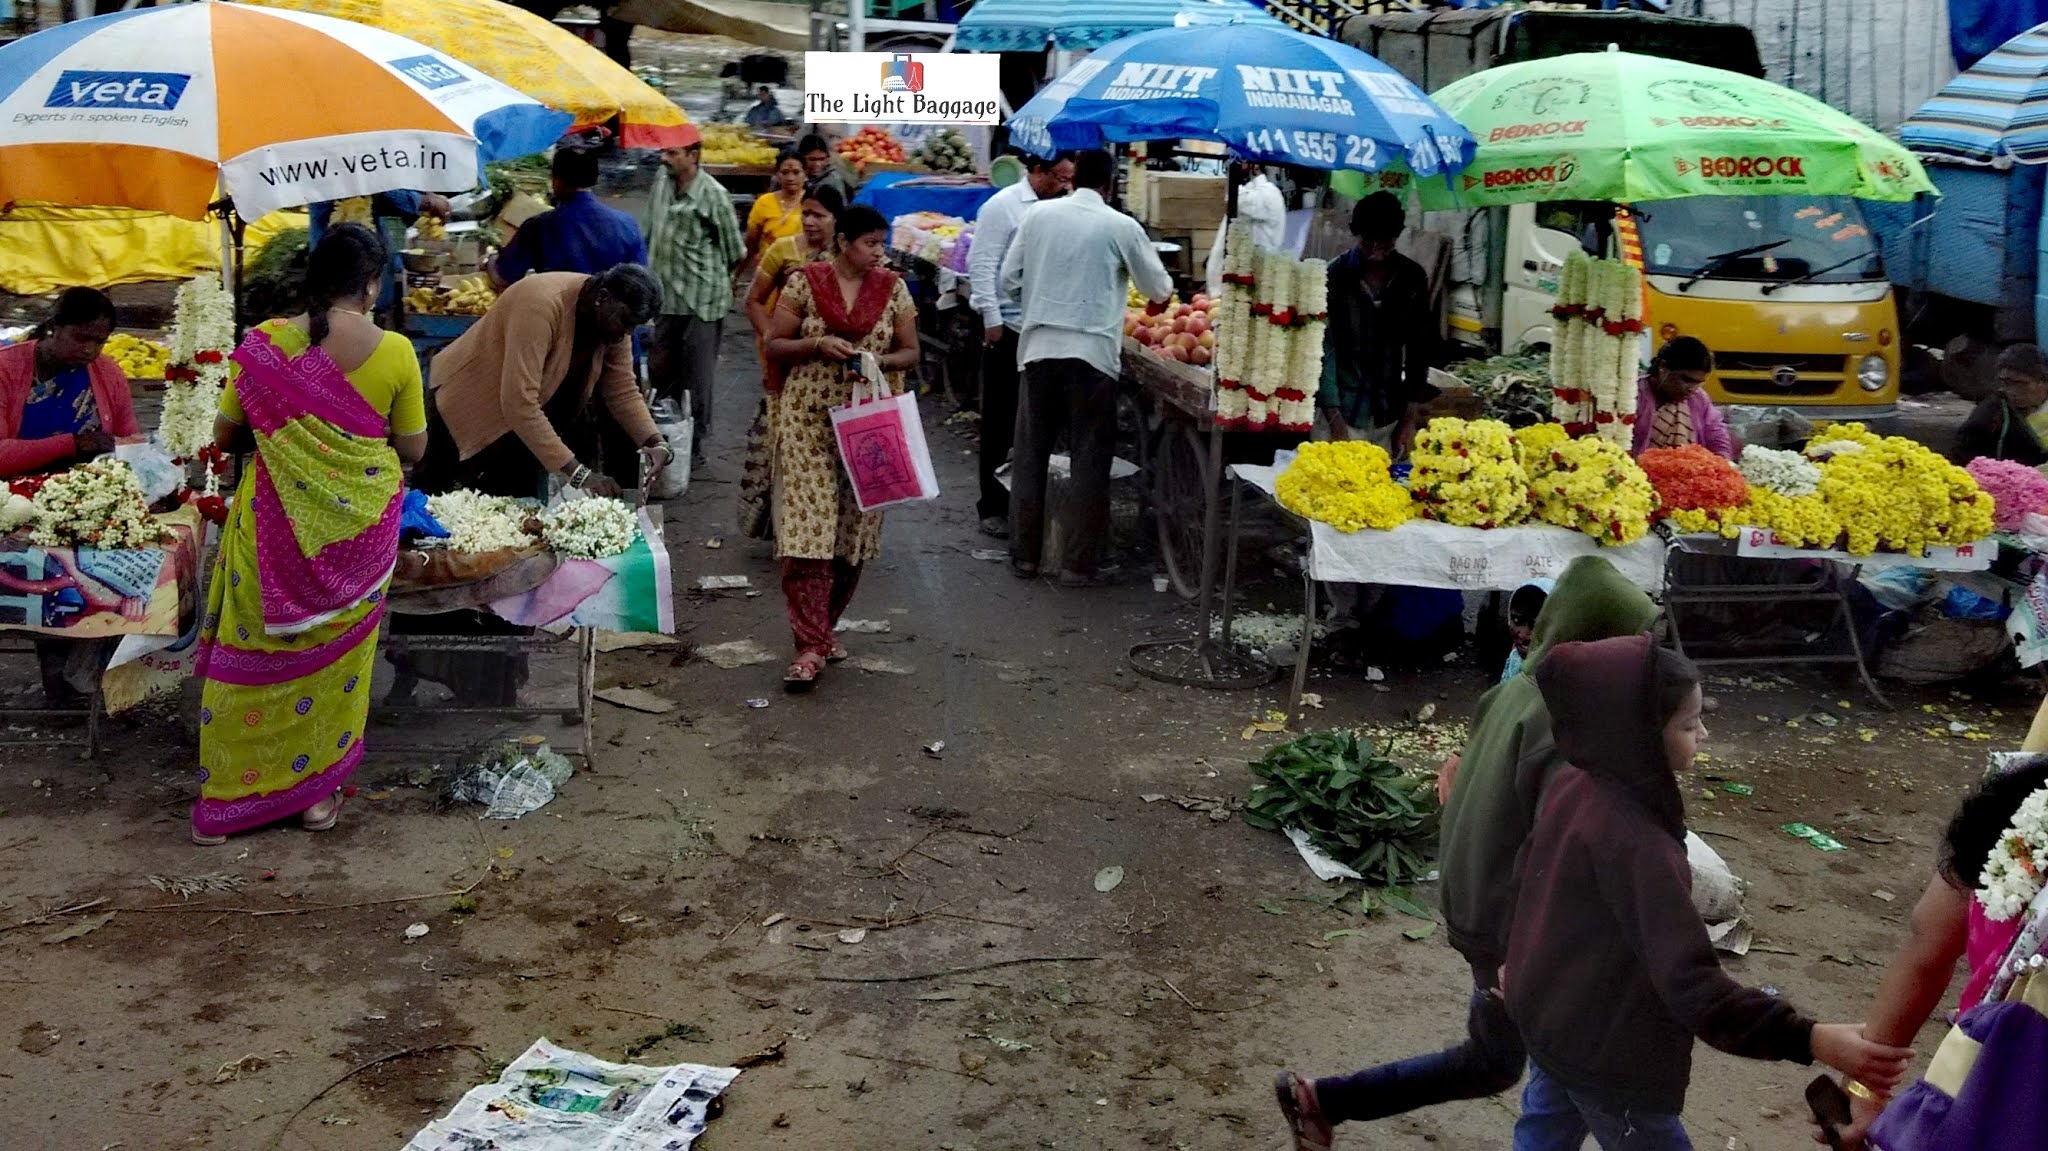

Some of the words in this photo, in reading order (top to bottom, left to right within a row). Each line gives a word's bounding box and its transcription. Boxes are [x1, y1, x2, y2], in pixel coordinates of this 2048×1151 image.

[403, 62, 461, 84] veta
[1109, 62, 1219, 92] NIIT
[1236, 64, 1345, 97] NIIT
[71, 78, 169, 104] veta
[1101, 87, 1200, 100] INDIRANA
[1245, 91, 1356, 116] INDIRANAGAR
[12, 112, 66, 125] Experts
[70, 113, 83, 122] in
[87, 112, 138, 124] spoken
[142, 114, 189, 127] English
[1679, 116, 1787, 128] BEDRO
[1488, 121, 1588, 142] BEDROCK
[1293, 131, 1338, 164] 555
[1344, 134, 1376, 168] 22
[260, 145, 447, 186] www.veta.in
[1700, 156, 1806, 177] BEDROCK
[1449, 556, 1471, 570] BAG
[1526, 555, 1553, 568] DATE
